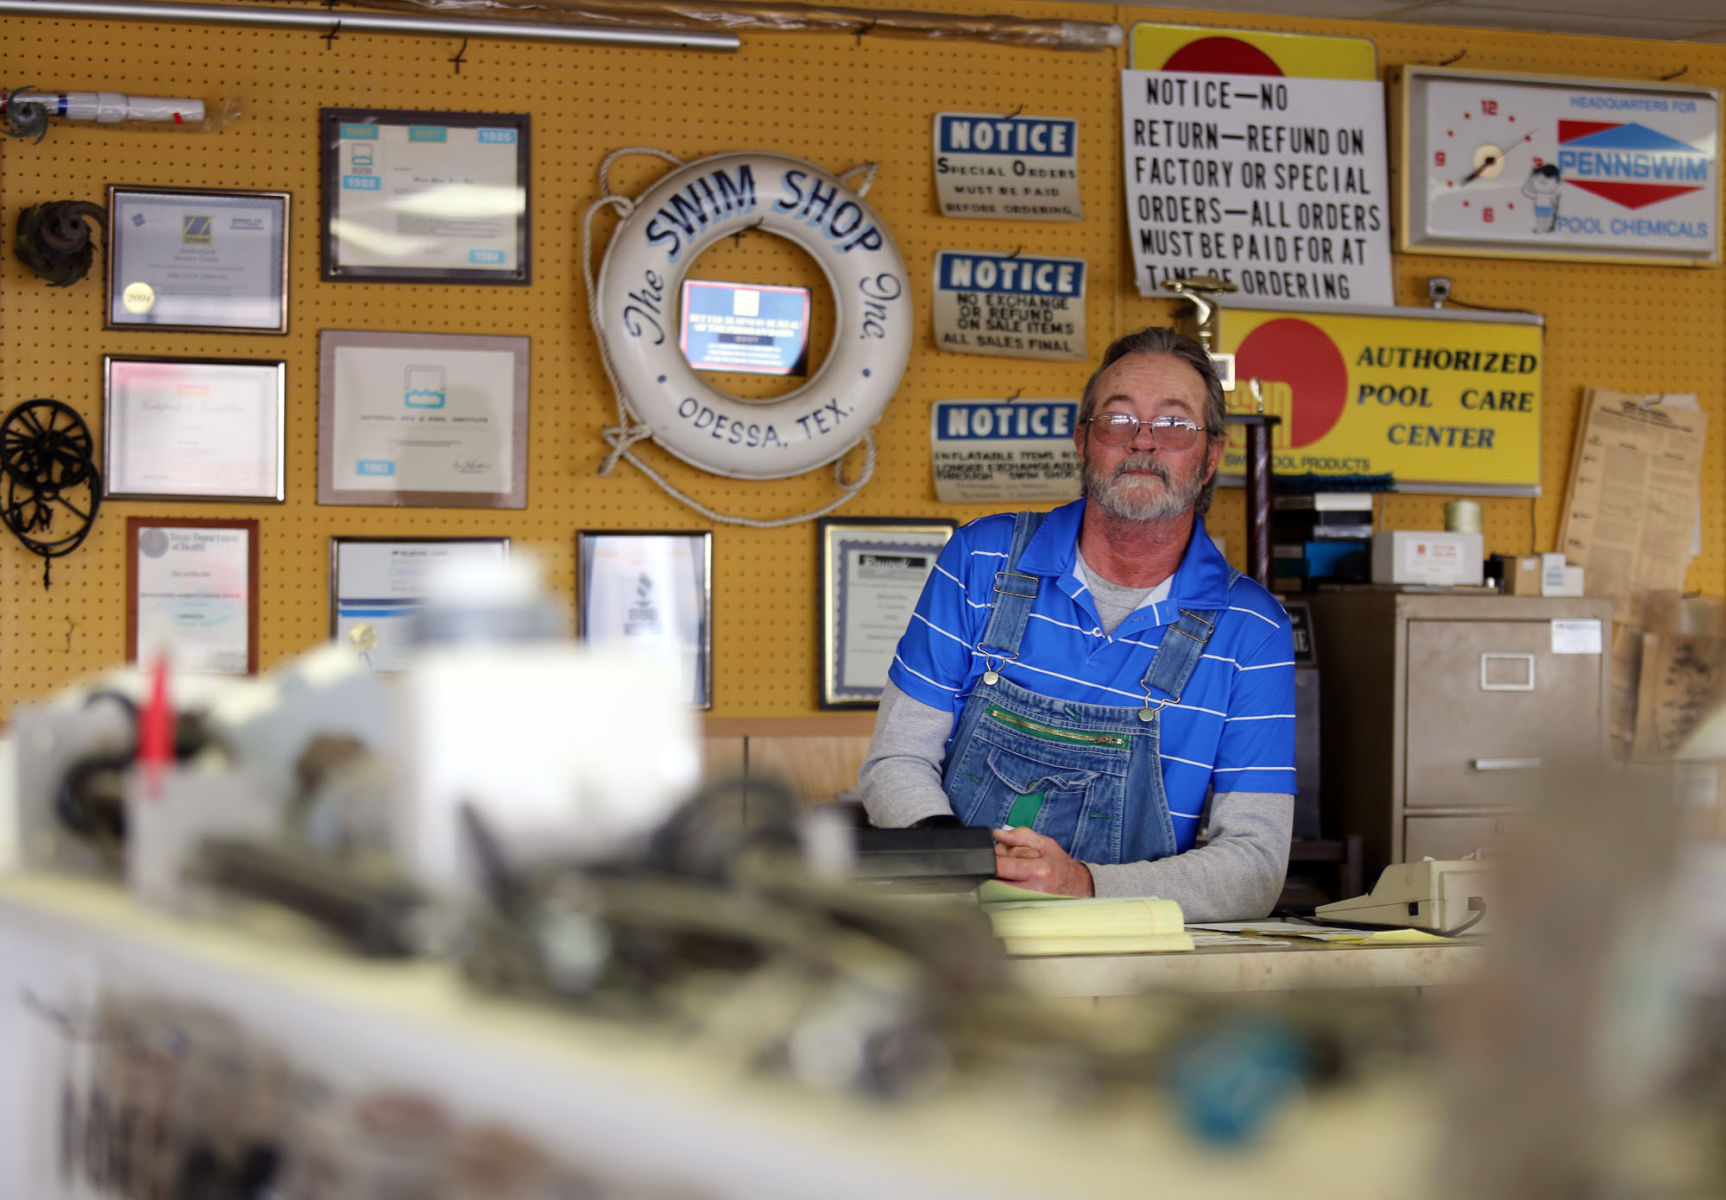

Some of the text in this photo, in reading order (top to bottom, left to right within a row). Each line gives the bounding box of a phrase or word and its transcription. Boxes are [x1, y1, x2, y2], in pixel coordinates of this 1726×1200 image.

[1481, 99, 1498, 115] 12
[1570, 96, 1697, 114] HEADQUARTERS FOR
[951, 121, 1068, 153] NOTICE
[1338, 128, 1364, 155] ON
[1434, 151, 1446, 167] 9
[1558, 151, 1708, 181] PENNSWIM
[1135, 156, 1371, 194] FACTORY OR SPECIAL
[954, 185, 1060, 197] MUST BE PAID
[946, 203, 997, 213] BEFORE
[1299, 203, 1380, 232] ORDERS
[1482, 207, 1494, 223] 6
[1558, 217, 1709, 238] POOL CHEMICALS
[623, 269, 665, 346] The
[646, 164, 757, 263] SWIM
[774, 169, 883, 254] SHOP
[1140, 229, 1366, 265] MUST BE PAID FOR AT
[951, 259, 1075, 293] NOTICE
[1242, 269, 1350, 300] ORDERING
[958, 293, 1069, 310] NO EXCHANGE
[960, 306, 1053, 323] OR REFUND
[958, 318, 1074, 336] ON SALE ITEMS
[944, 333, 1072, 353] ALL SALES FINAL
[1357, 346, 1537, 375] AUTHORIZED
[1357, 384, 1535, 413] POOL CARE
[796, 398, 855, 440] TEX.
[948, 407, 1069, 437] NOTICE
[1388, 423, 1495, 449] CENTER
[1272, 455, 1296, 468] OOL
[1301, 456, 1370, 471] PRODUCTS
